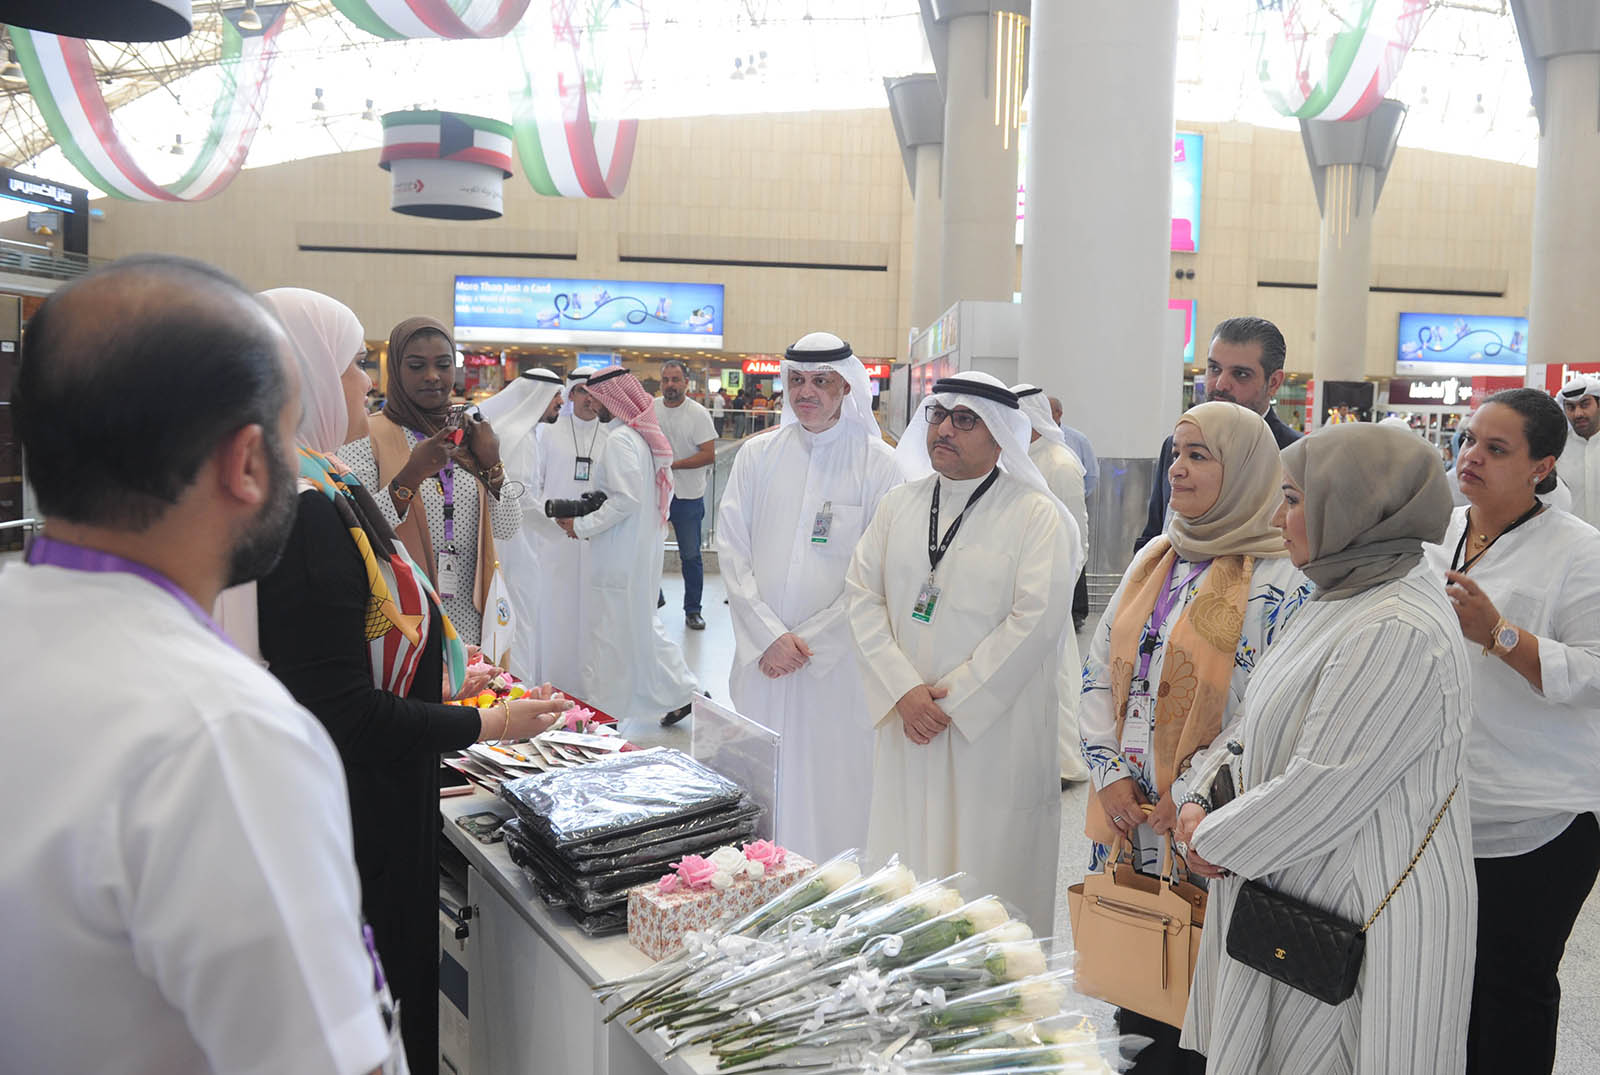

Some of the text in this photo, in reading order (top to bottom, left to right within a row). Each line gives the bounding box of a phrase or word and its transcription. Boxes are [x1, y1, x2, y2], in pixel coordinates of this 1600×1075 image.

[456, 281, 552, 294] More Than Just a Card
[747, 362, 760, 372] Al
